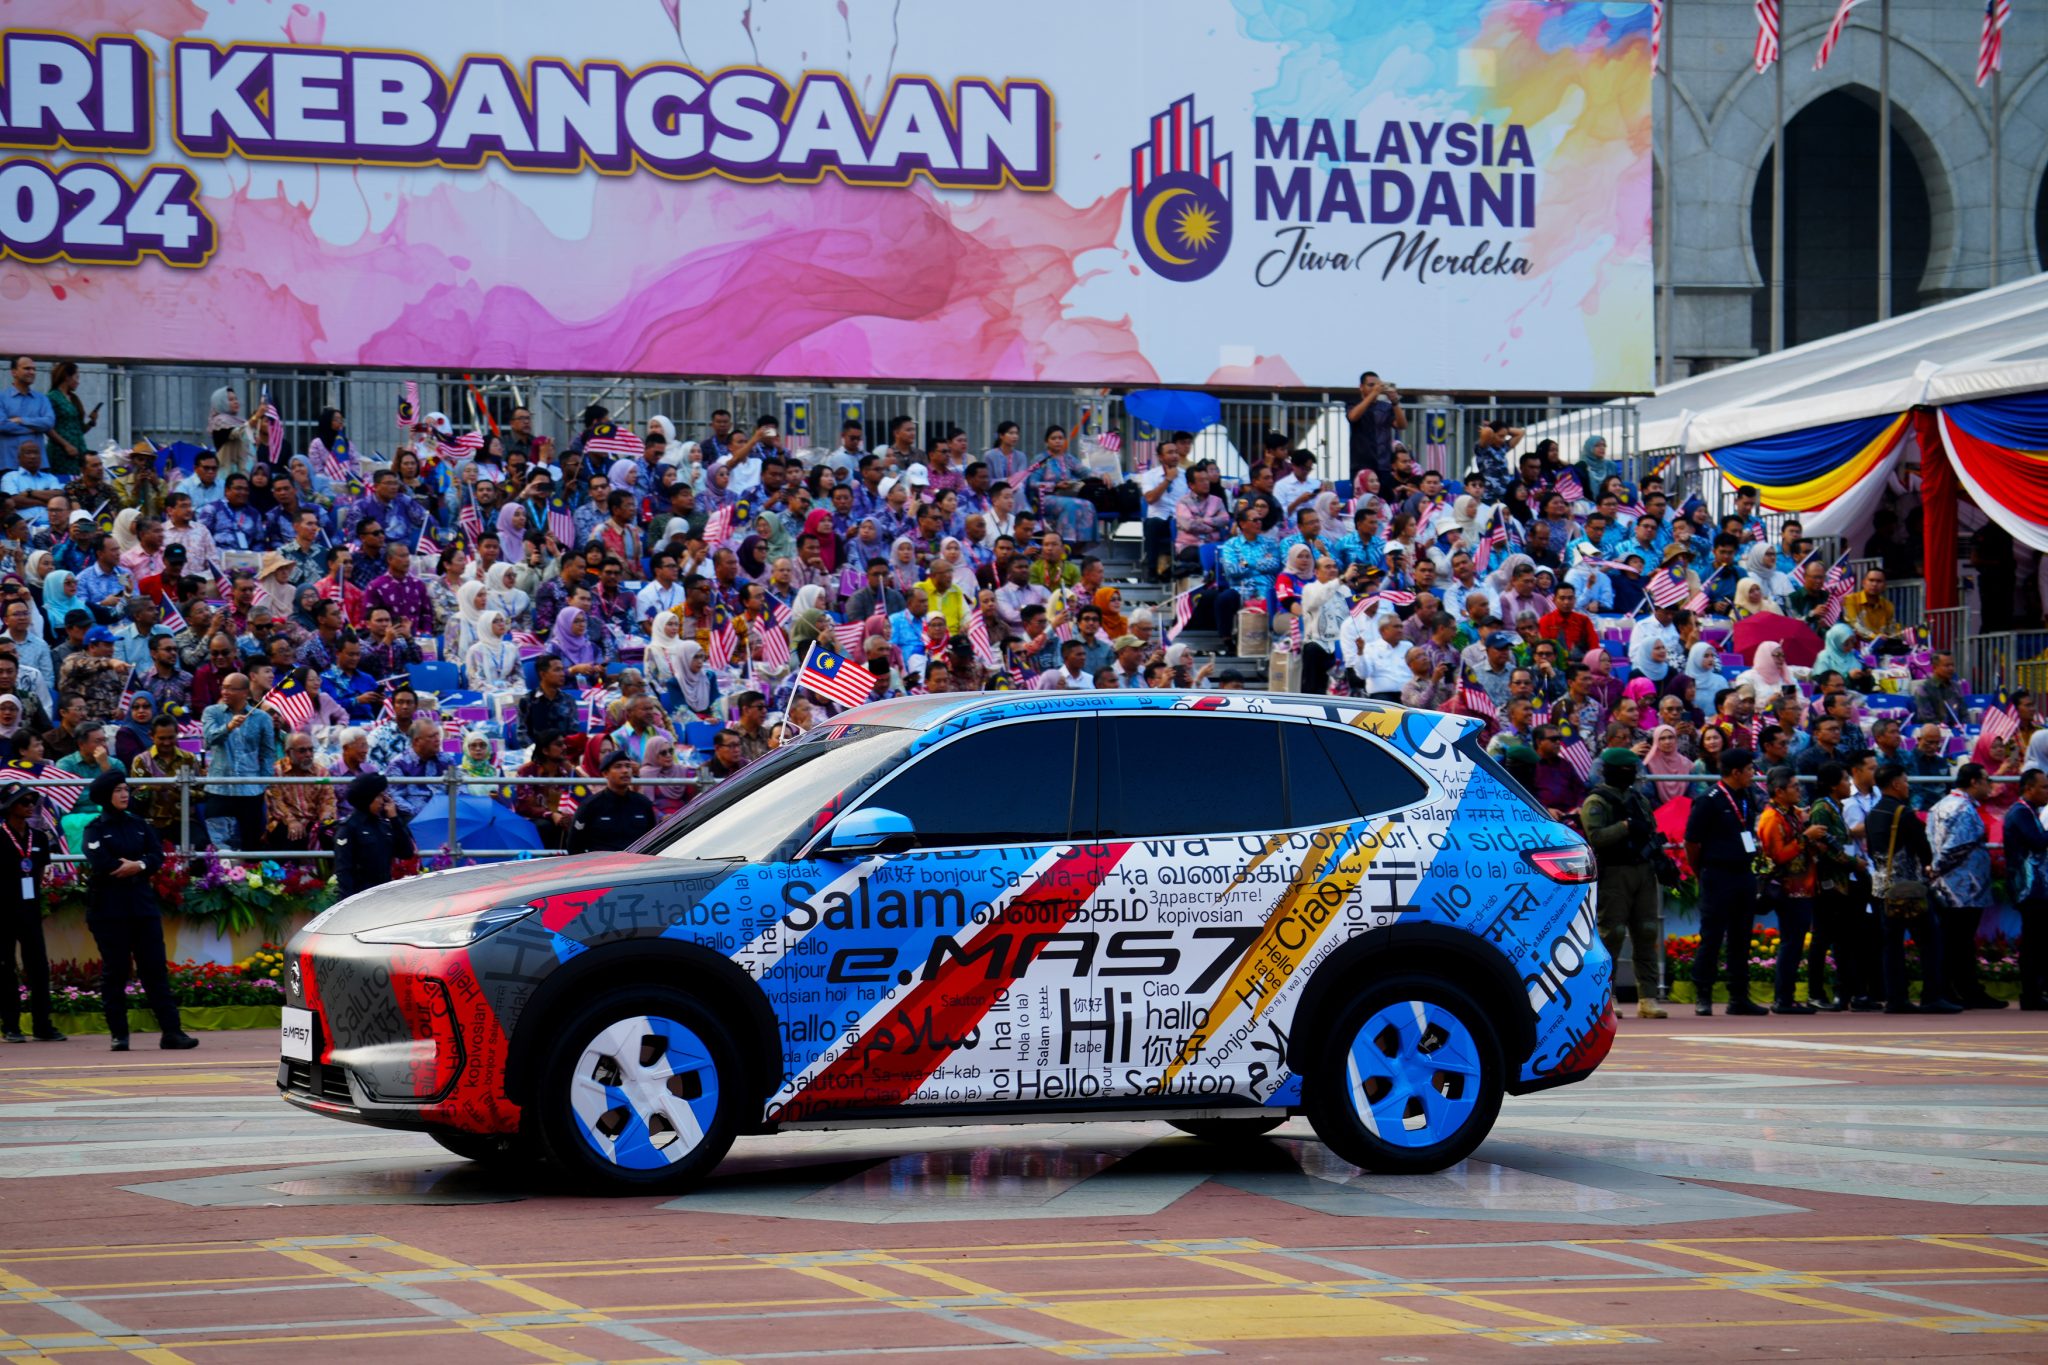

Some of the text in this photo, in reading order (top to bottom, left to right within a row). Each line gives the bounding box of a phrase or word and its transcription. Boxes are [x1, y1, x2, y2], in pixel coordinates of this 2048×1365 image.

[0, 36, 1040, 173] RI KEBANGSAAN
[1254, 116, 1536, 168] MALAYSIA
[1254, 165, 1536, 228] MADANI
[1254, 225, 1535, 288] Jiwa Merdeka
[1411, 805, 1461, 822] Salam
[1428, 827, 1556, 852] oi sidak
[758, 864, 822, 880] oi sidak
[873, 865, 915, 884] 你好
[921, 867, 987, 888] bonjour
[1421, 859, 1459, 879] Hola
[1368, 860, 1421, 913] Hi
[652, 895, 731, 927] tabe
[781, 876, 965, 932] Salam
[1158, 907, 1243, 927] kopivosian
[1257, 882, 1297, 925] bonjour
[1275, 881, 1343, 951] Ciao
[1549, 902, 1569, 925] Salam
[739, 917, 755, 954] Hola
[757, 904, 777, 955] hallo
[784, 937, 829, 957] Hello
[826, 926, 1265, 986] e.MAS7
[1260, 937, 1294, 977] Hello
[447, 961, 481, 1004] Hello
[762, 962, 826, 984] bonjour
[1142, 980, 1180, 998] Ciao
[1254, 958, 1282, 990] tabe
[825, 987, 847, 1002] hoi
[1073, 998, 1103, 1013] 你好
[1235, 974, 1269, 1011] Hi
[776, 1014, 837, 1043] hallo
[1059, 987, 1133, 1065] Hi
[1146, 1000, 1210, 1030] hallo
[282, 1026, 310, 1047] e.MAS7
[464, 1002, 489, 1088] kopivosian
[842, 1010, 864, 1062] Hello
[1016, 1032, 1030, 1062] Hola
[1036, 1026, 1050, 1067] Salam
[1074, 1041, 1102, 1054] tabe
[1142, 1034, 1207, 1068] 你好
[1205, 1014, 1261, 1070] bonjour
[782, 1071, 864, 1094] Saluton
[906, 1086, 940, 1101] Hola
[1015, 1067, 1100, 1100] Hello
[1123, 1068, 1236, 1098] Saluton
